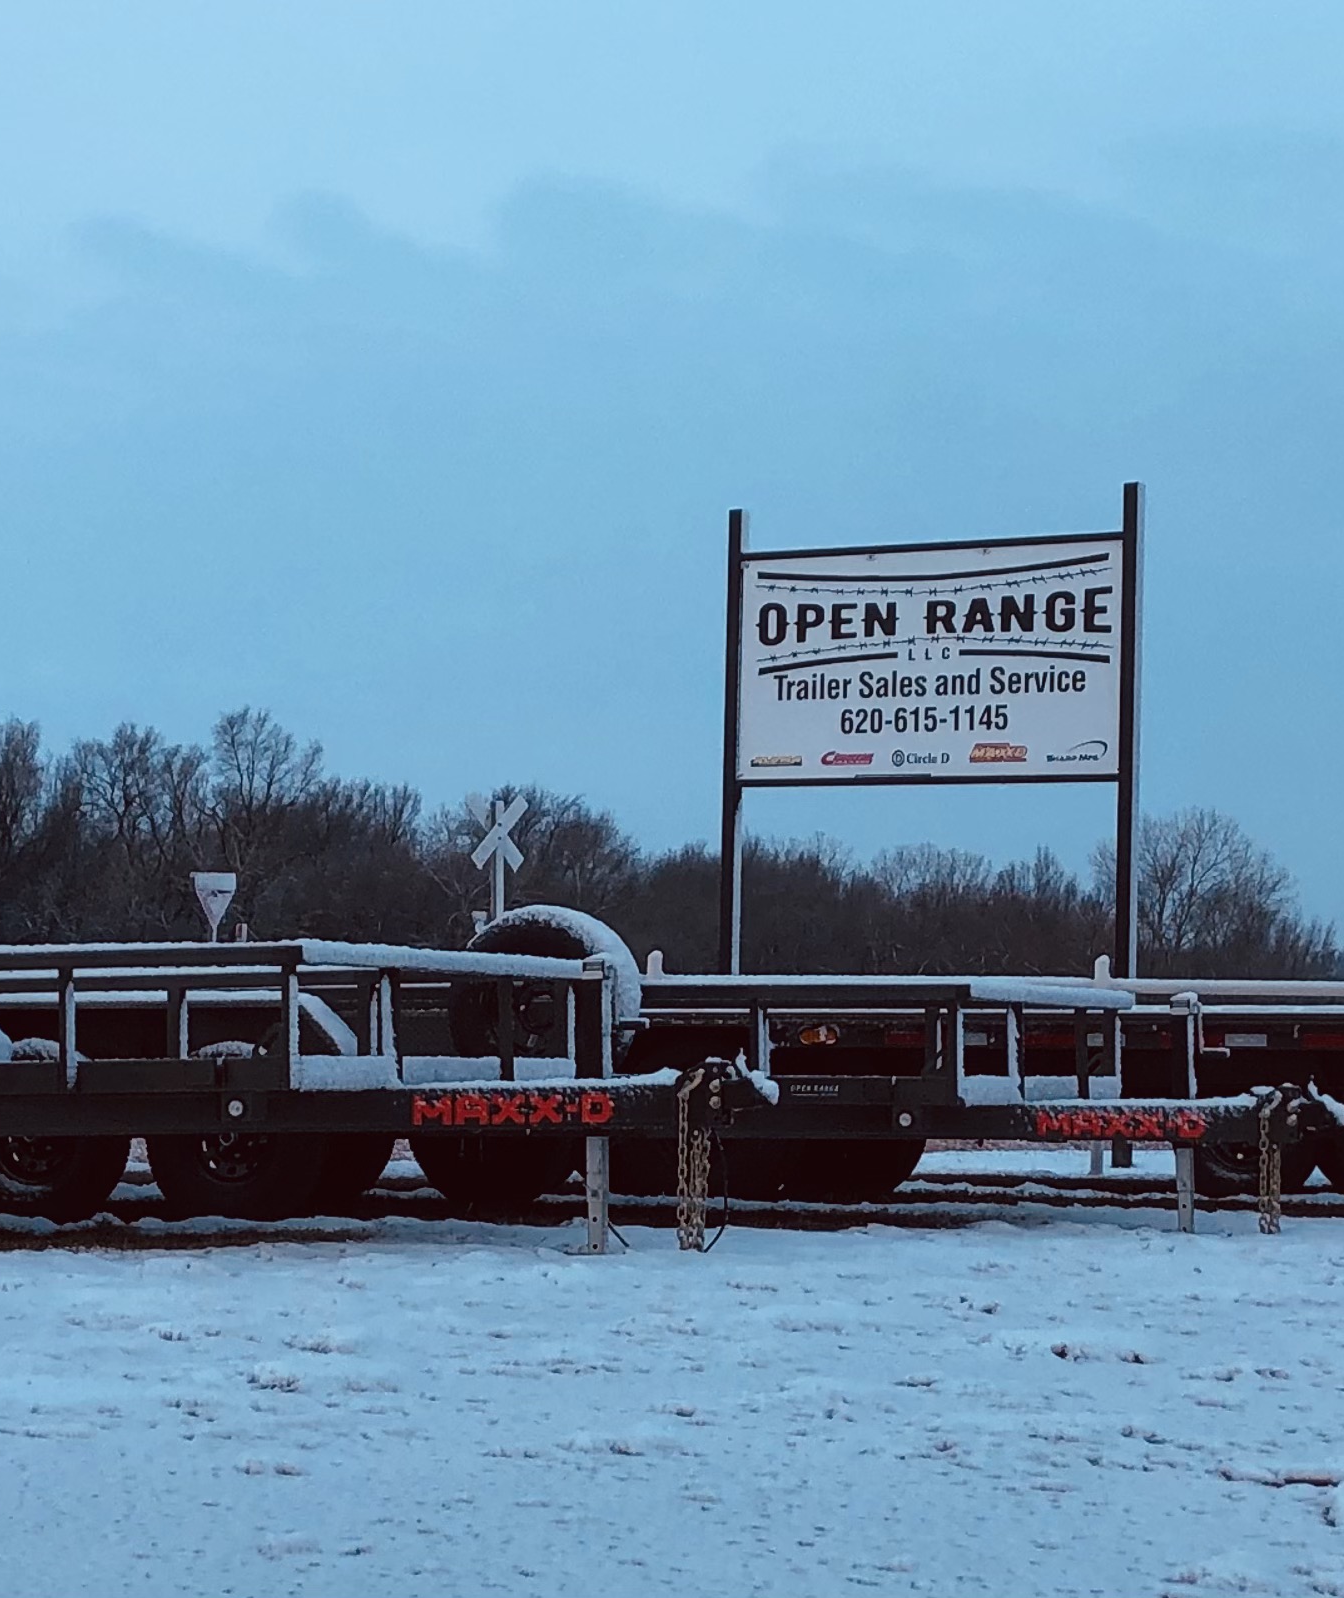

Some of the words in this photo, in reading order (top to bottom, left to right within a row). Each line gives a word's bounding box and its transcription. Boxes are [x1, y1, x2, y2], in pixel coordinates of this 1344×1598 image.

[756, 602, 899, 645] OPEN
[923, 586, 1112, 634] RANGE
[908, 647, 951, 661] LLC
[774, 673, 852, 701] Trailer
[859, 670, 927, 699] Sales
[935, 668, 981, 696] and
[989, 665, 1086, 694] Service
[840, 705, 1009, 734] 620-615-1145
[907, 752, 937, 764] Circle
[941, 753, 950, 764] D
[412, 1093, 614, 1126] MAXX-D
